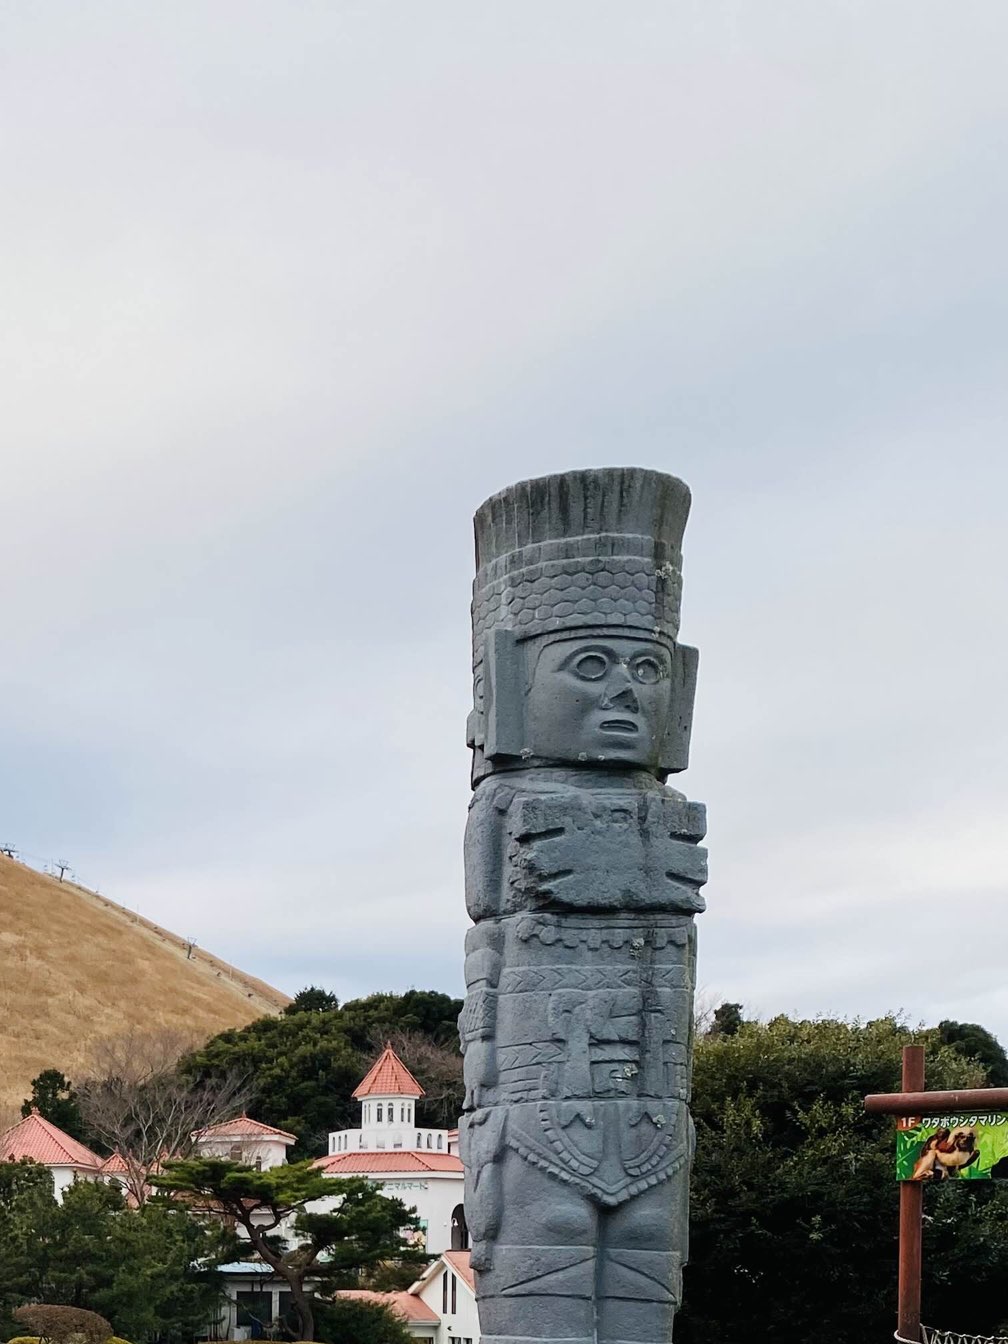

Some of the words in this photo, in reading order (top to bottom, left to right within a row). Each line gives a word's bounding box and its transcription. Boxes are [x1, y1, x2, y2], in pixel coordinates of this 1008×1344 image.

[901, 1117, 916, 1128] 1F
[922, 1114, 1006, 1128] ワタボウシタマリン
